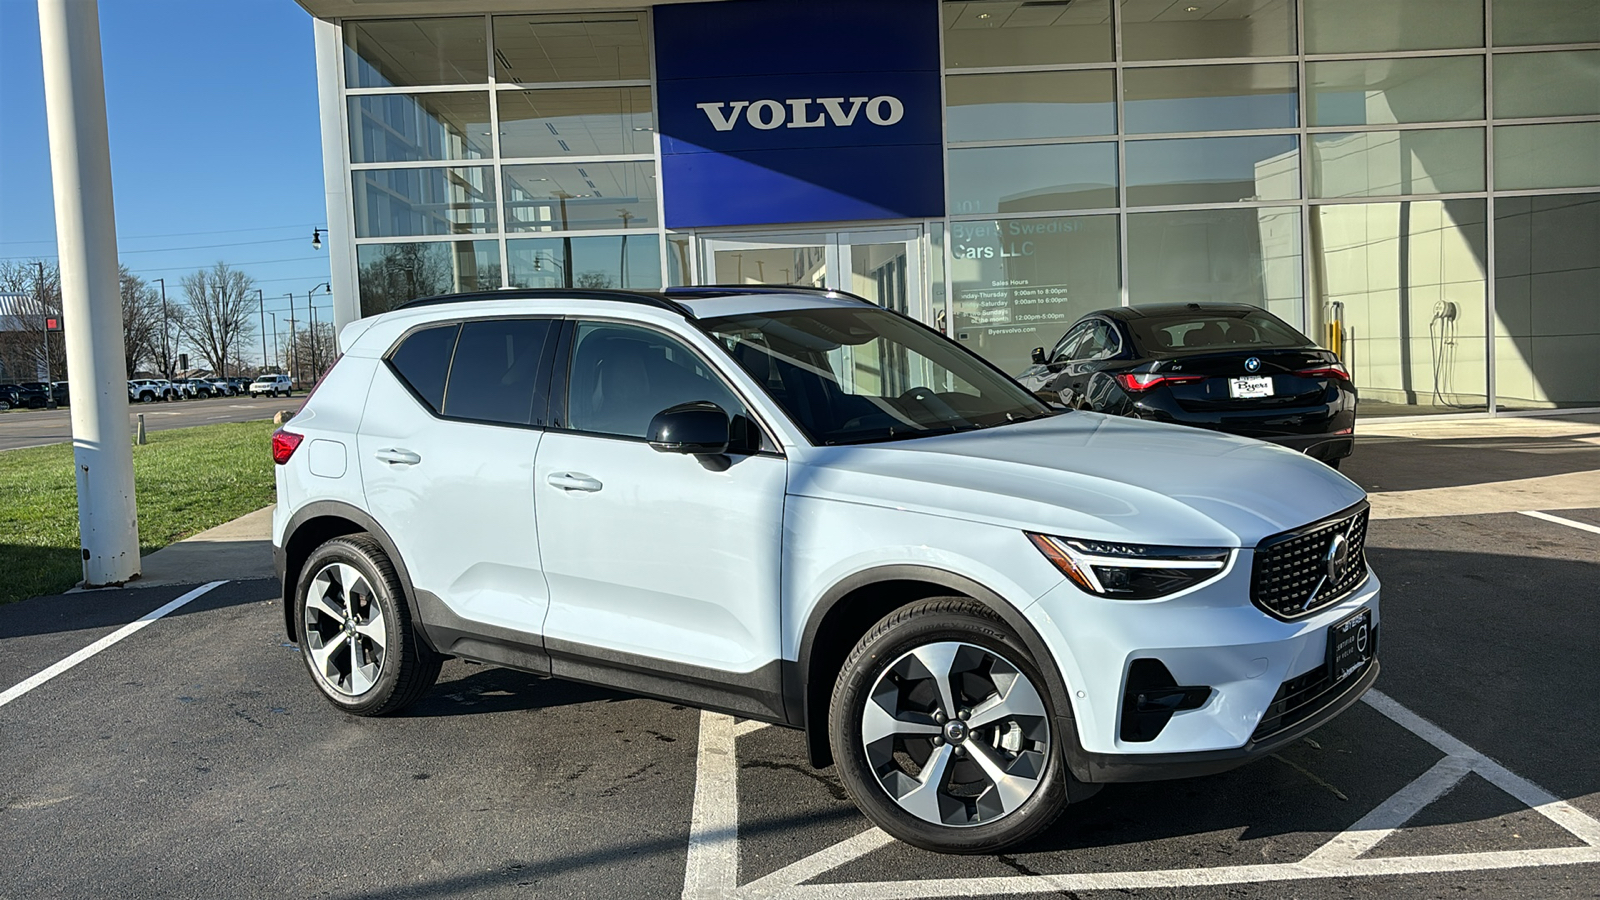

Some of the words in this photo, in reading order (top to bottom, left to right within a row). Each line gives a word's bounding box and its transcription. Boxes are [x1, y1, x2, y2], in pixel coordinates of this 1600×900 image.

[696, 95, 905, 131] VOLVO
[953, 223, 1003, 242] Byers
[953, 244, 994, 260] Cars
[1000, 241, 1034, 257] LLC
[961, 291, 1008, 300] nday-Thursday
[1014, 289, 1036, 297] 9:00am
[1045, 288, 1068, 296] 8:00pm
[1014, 298, 1036, 306] 9:00am
[1045, 297, 1068, 305] 6:00pm
[988, 327, 1036, 336] Byersvolvo.com
[1233, 380, 1269, 392] Byers
